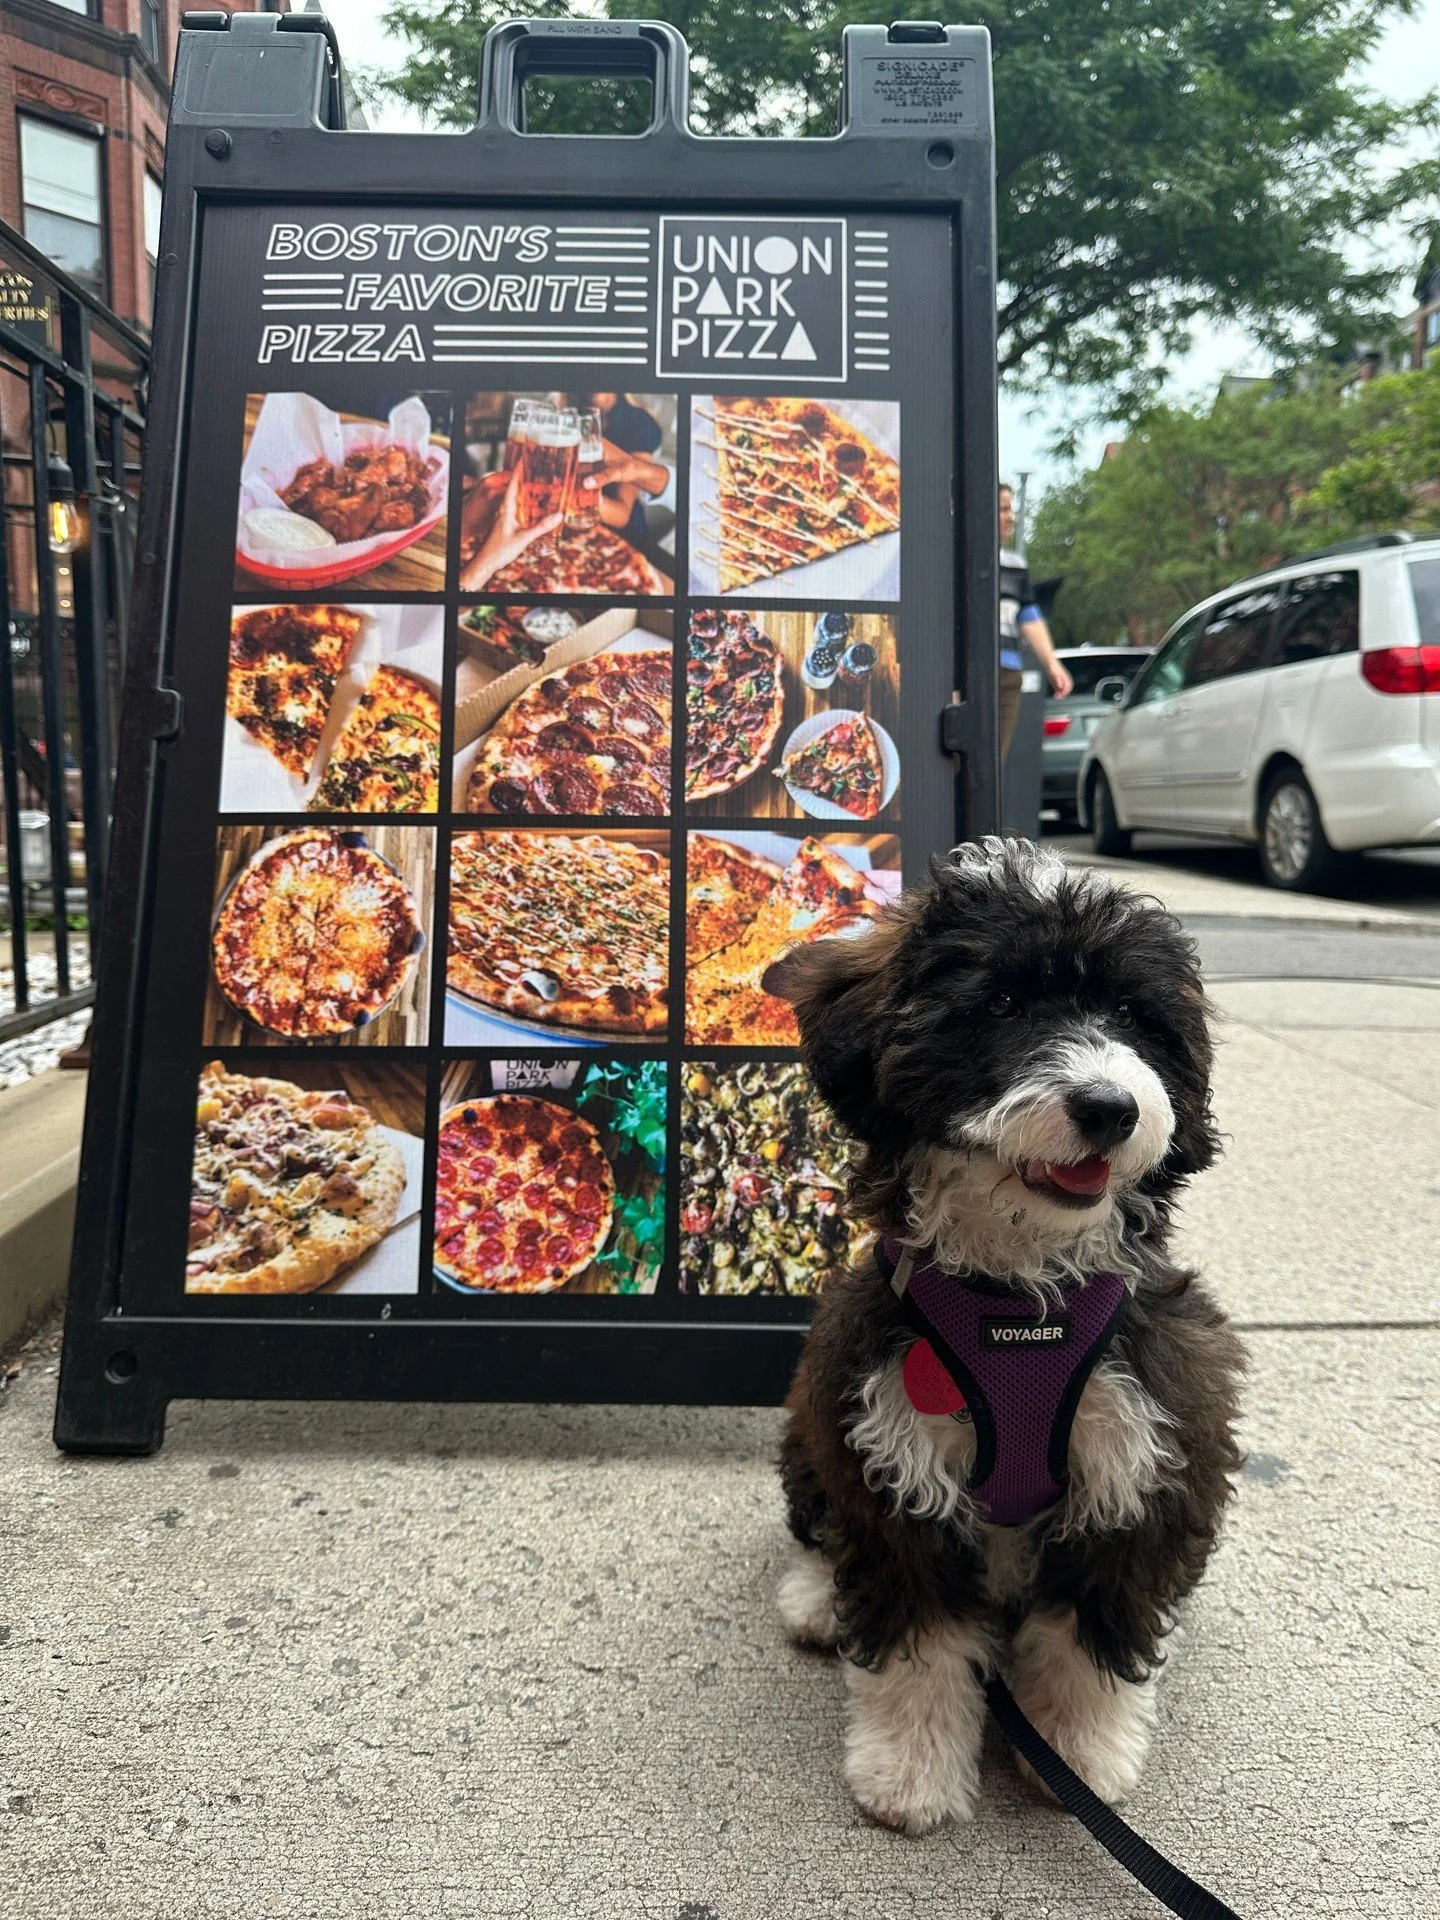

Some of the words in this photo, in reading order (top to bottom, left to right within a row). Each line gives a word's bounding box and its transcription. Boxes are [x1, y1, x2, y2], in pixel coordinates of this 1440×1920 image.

[567, 25, 591, 34] WITH
[593, 26, 622, 34] SAND
[265, 223, 552, 263] BOSTON'S
[673, 235, 833, 275] UNION
[344, 273, 612, 313] FAVORITE
[672, 276, 796, 317] PARK
[257, 324, 426, 364] PIZZA
[671, 318, 818, 361] PIZZA
[506, 1070, 551, 1080] PARK
[507, 1060, 568, 1069] UNION
[991, 1327, 1063, 1342] VOYAGER
